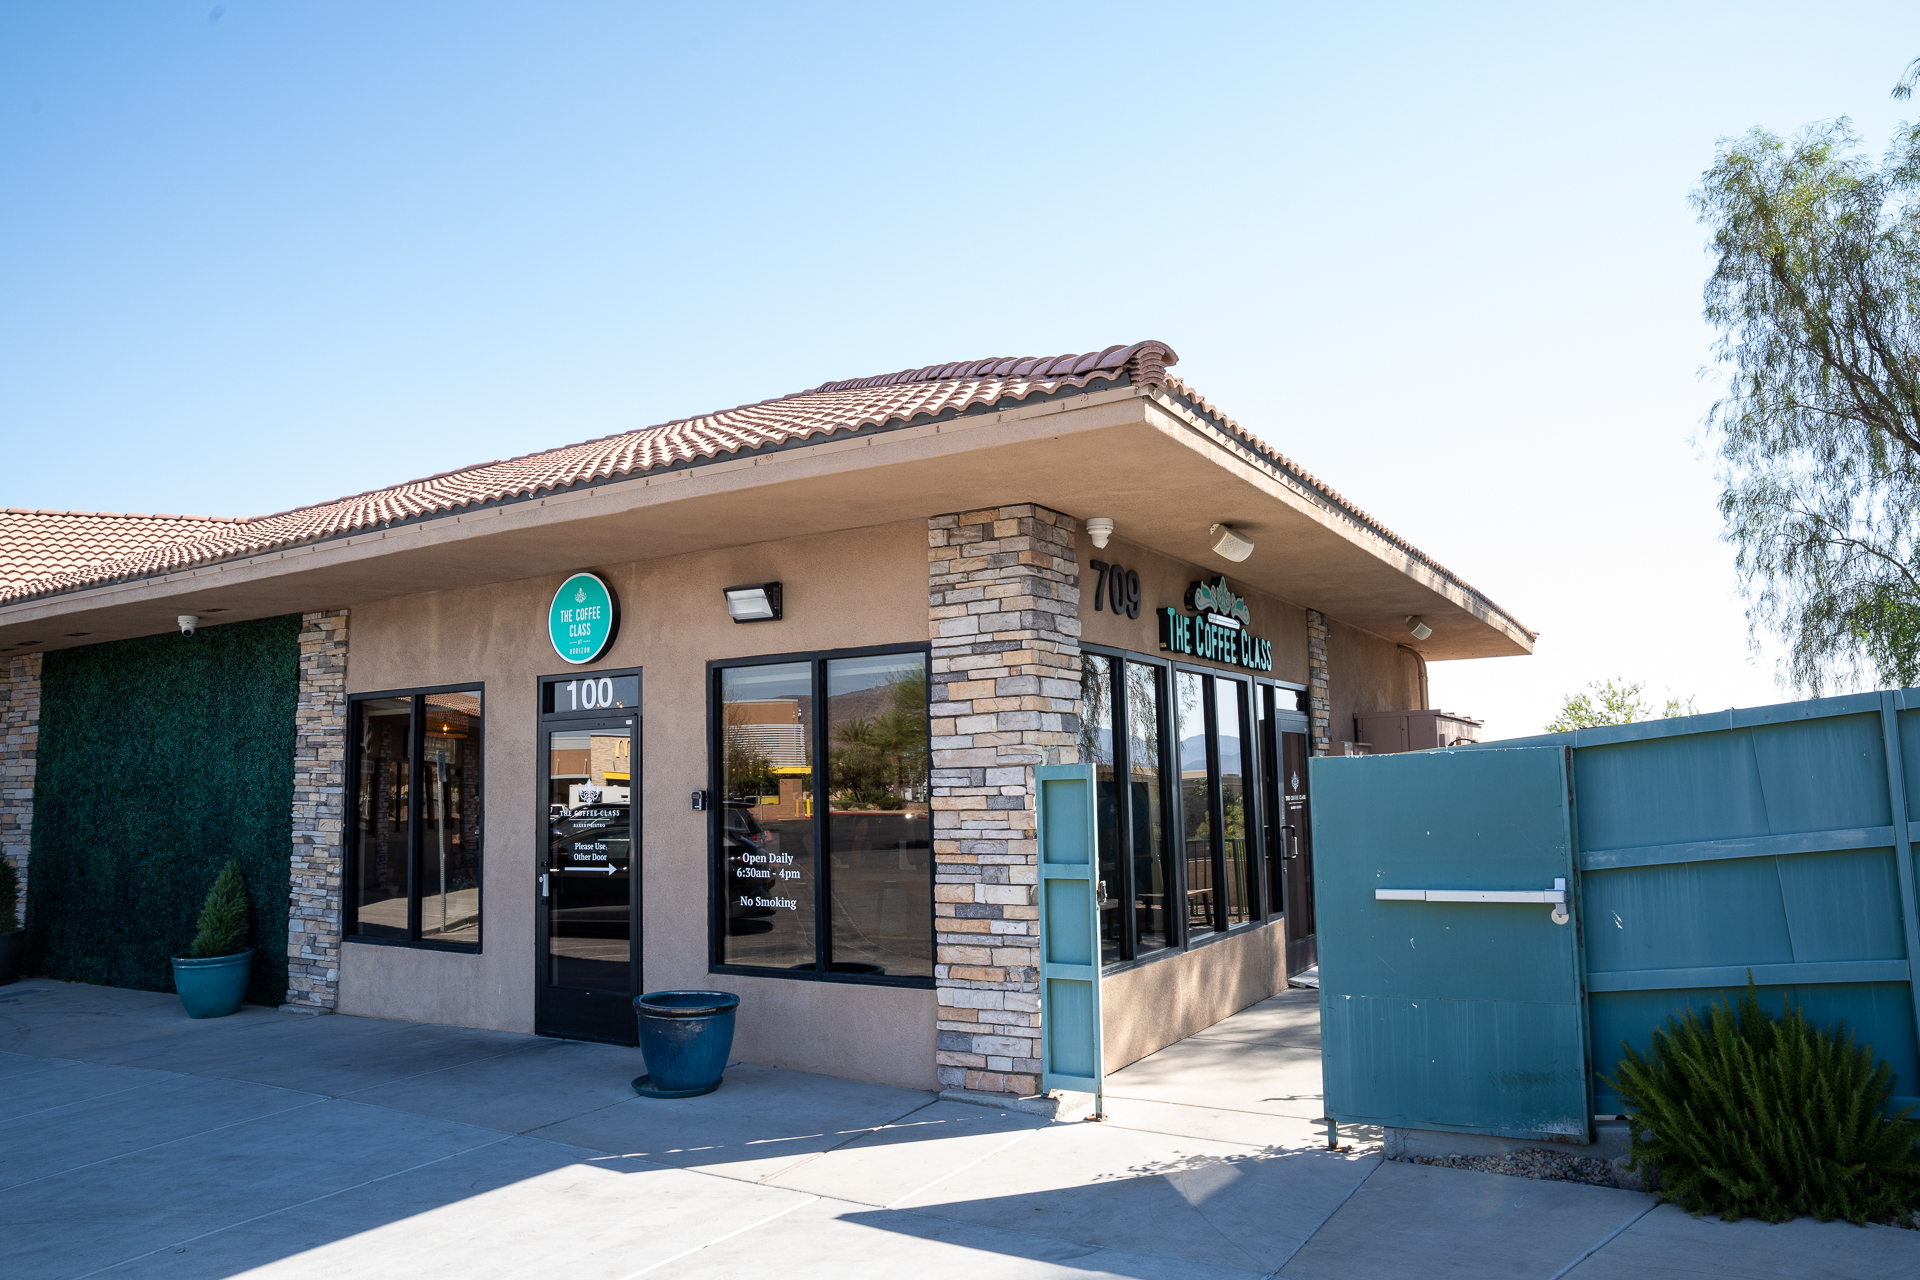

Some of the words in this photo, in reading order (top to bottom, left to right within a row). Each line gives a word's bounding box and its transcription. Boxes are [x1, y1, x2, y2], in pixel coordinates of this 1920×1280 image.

[1090, 560, 1141, 619] 709
[560, 609, 573, 623] THE
[576, 606, 601, 621] COFFEE
[569, 623, 591, 637] CLASS
[1167, 607, 1191, 654] THE
[1195, 615, 1237, 664] COFFEE
[1240, 628, 1272, 672] CLASS
[569, 647, 590, 655] HORIZON
[566, 677, 613, 710] 100
[573, 853, 591, 861] Other
[592, 853, 607, 861] Door
[742, 853, 766, 865] Open
[769, 853, 793, 865] Daily
[736, 867, 770, 878] 6:30am
[779, 868, 800, 880] 4pm
[740, 896, 754, 906] No
[755, 896, 797, 910] Smoking
